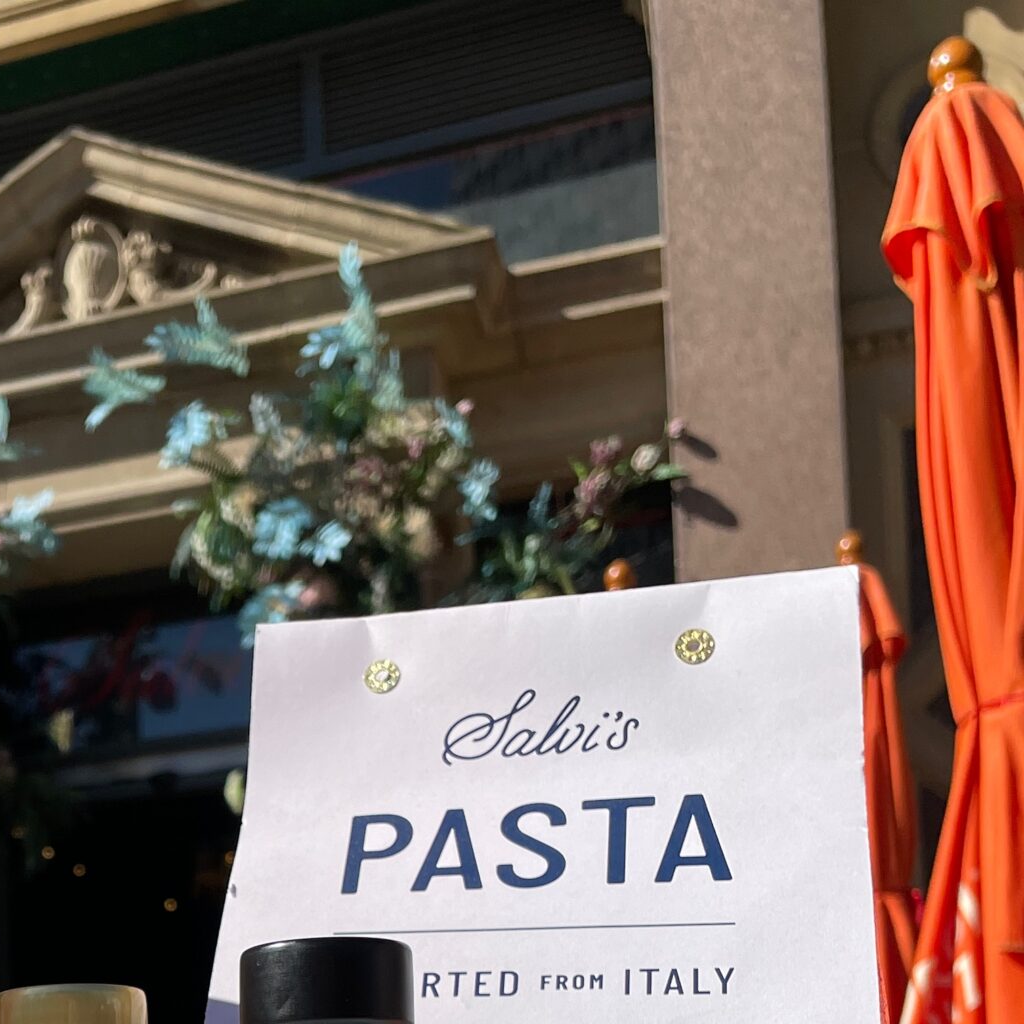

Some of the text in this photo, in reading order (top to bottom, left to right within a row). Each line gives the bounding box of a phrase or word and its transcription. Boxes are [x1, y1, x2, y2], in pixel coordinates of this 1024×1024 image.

[442, 689, 640, 766] Salvi's
[340, 793, 733, 895] PASTA
[420, 967, 735, 998] RTED FROM ITALY
